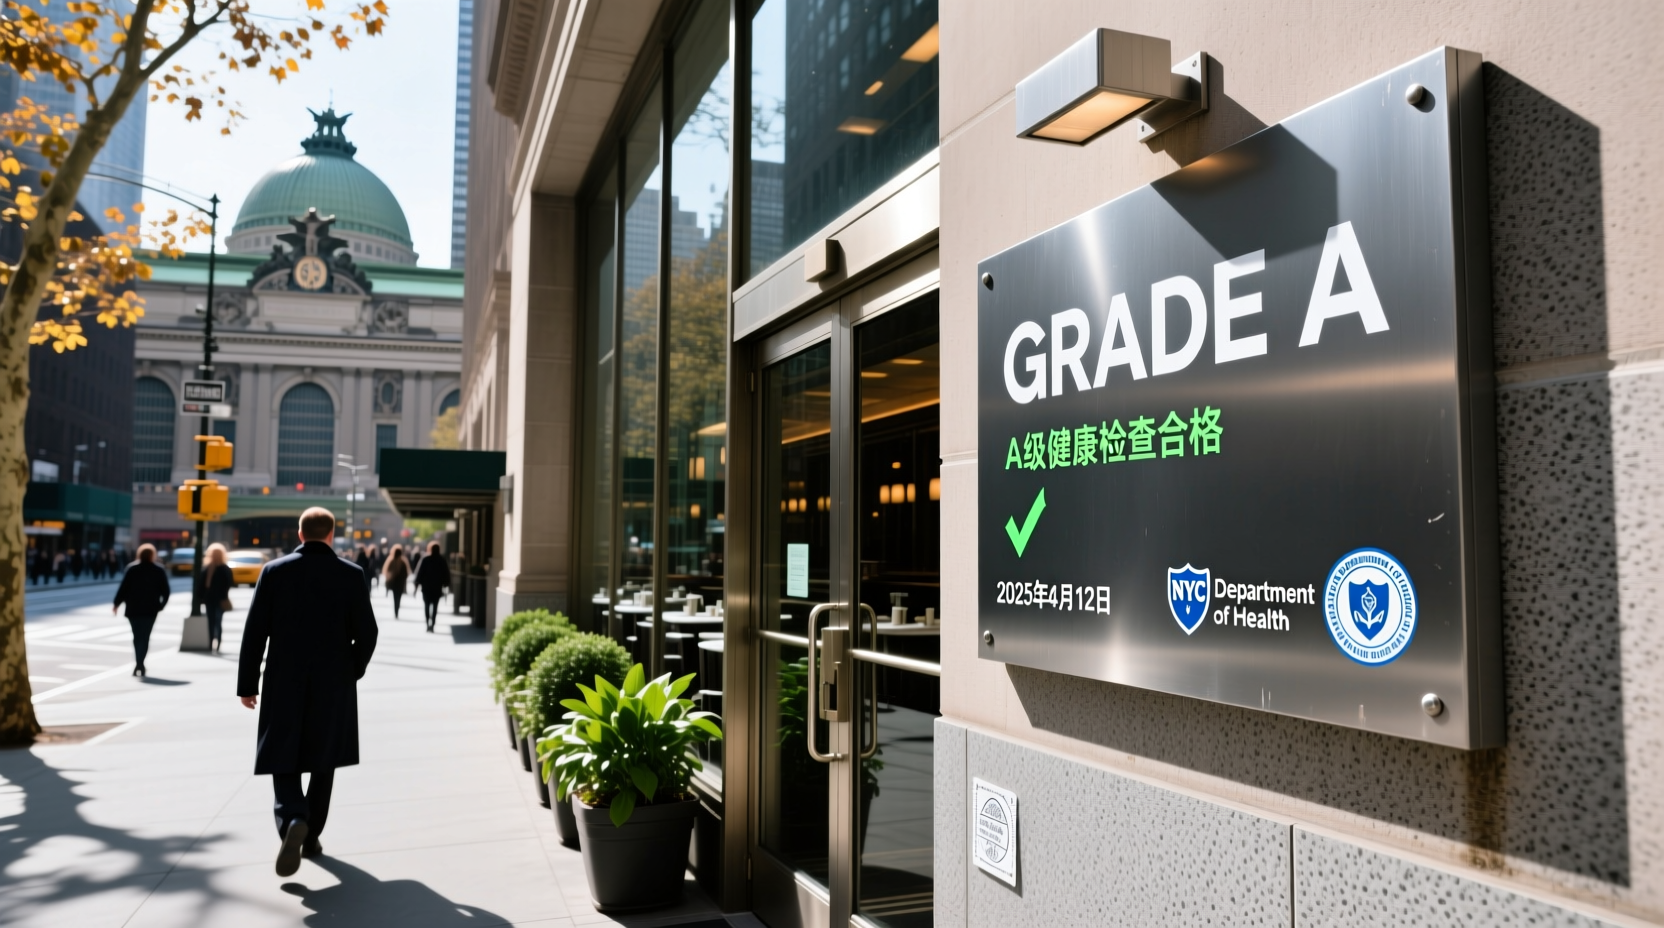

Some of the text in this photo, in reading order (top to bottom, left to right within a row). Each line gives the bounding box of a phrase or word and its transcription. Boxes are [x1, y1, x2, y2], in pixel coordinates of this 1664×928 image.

[1003, 220, 1390, 405] GRADE A
[1005, 405, 1224, 471] A级健康检查合格
[996, 579, 1111, 615] 2025年4月12日
[1171, 579, 1206, 603] NYC
[1214, 578, 1316, 605] Department
[1213, 606, 1290, 631] of Health
